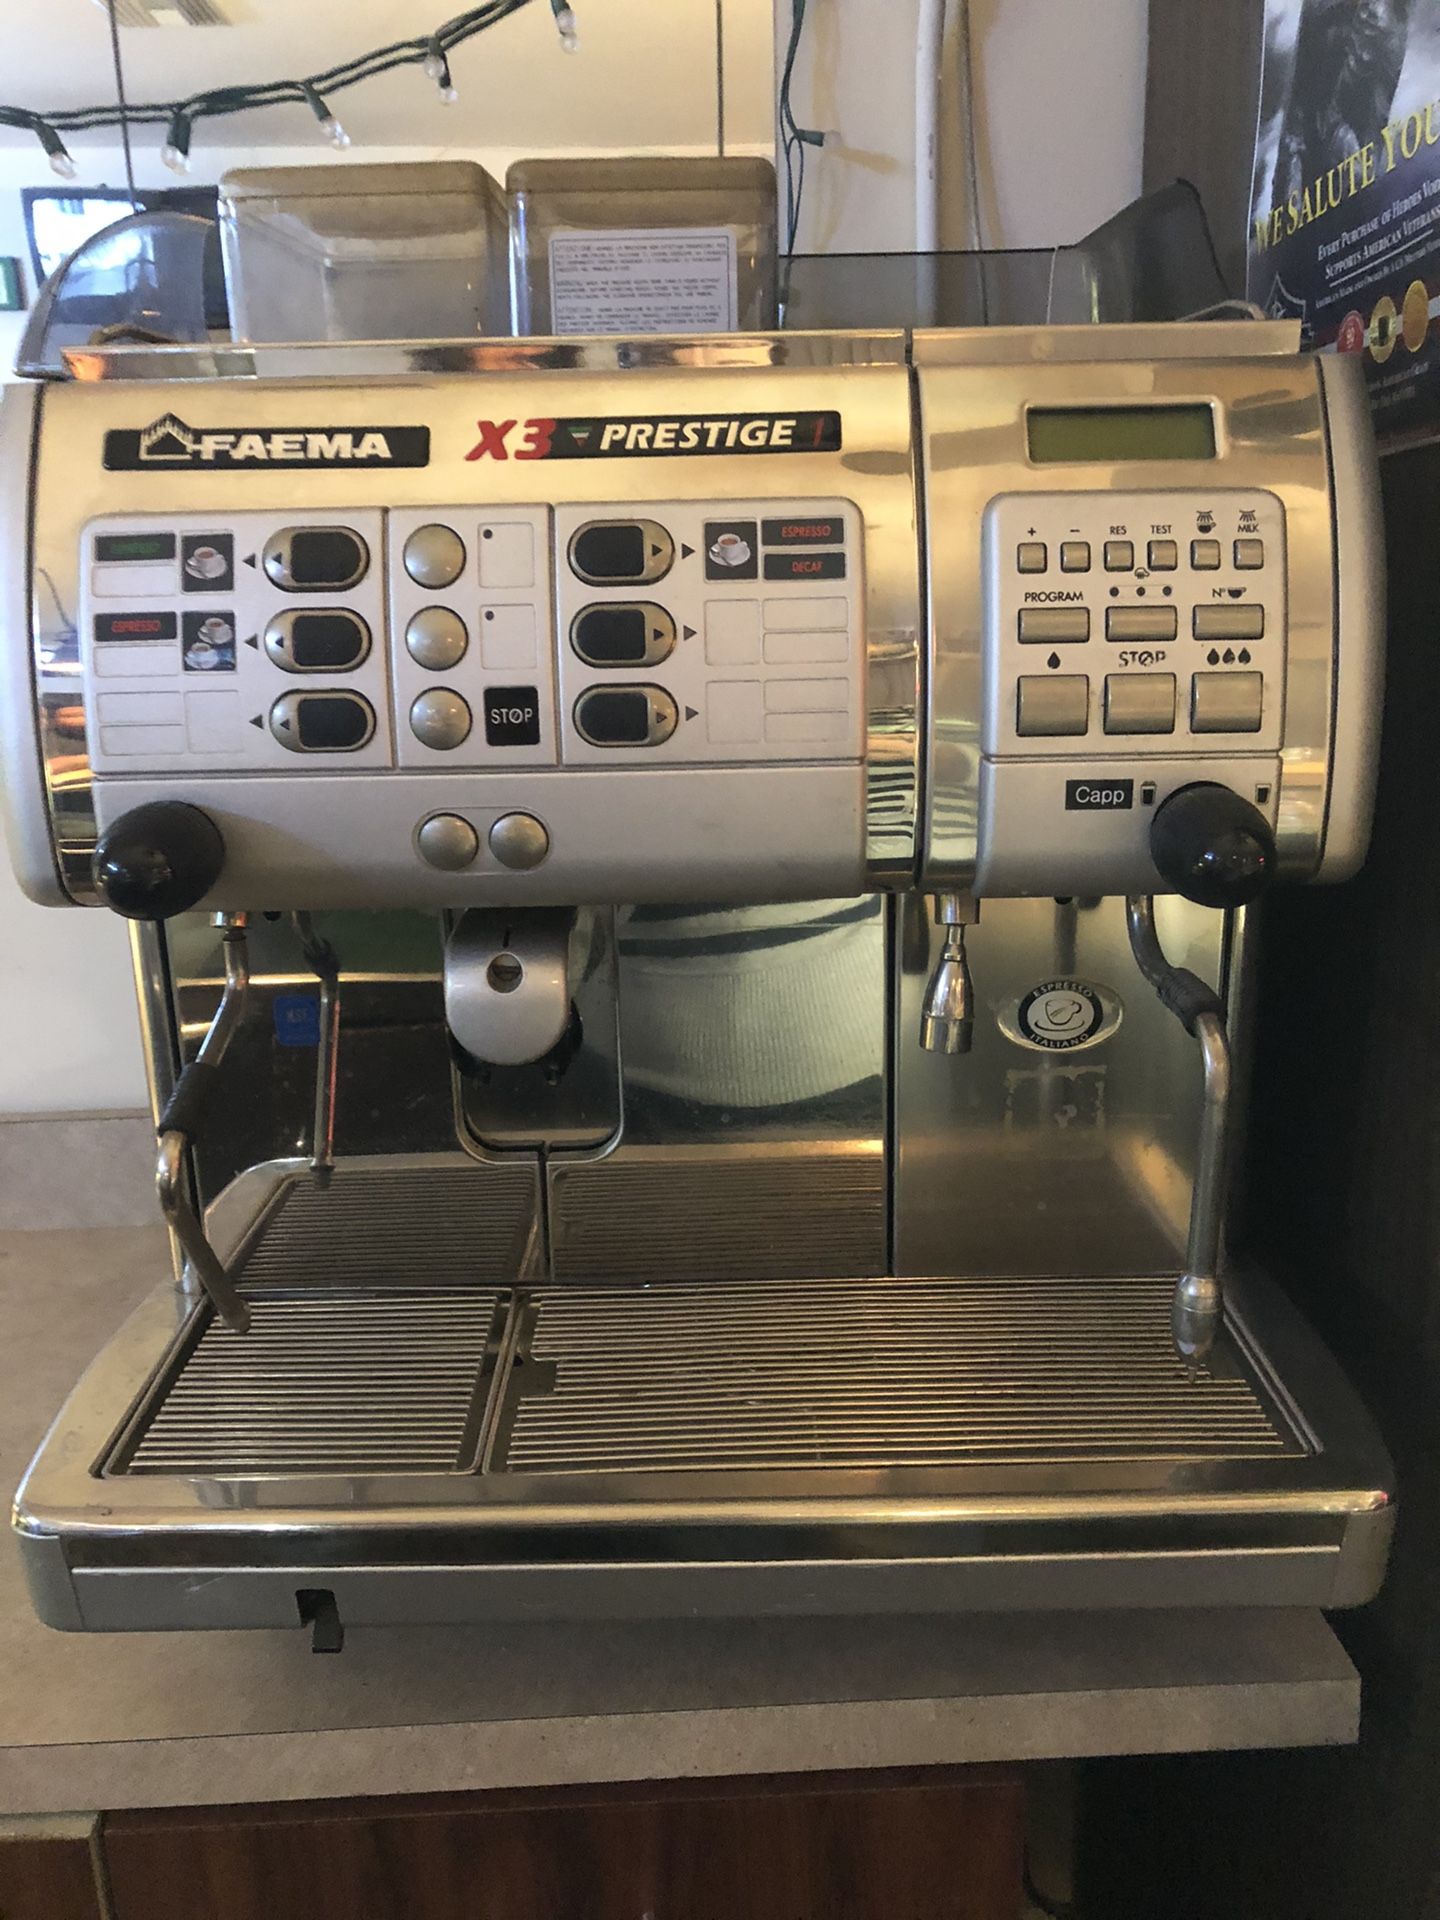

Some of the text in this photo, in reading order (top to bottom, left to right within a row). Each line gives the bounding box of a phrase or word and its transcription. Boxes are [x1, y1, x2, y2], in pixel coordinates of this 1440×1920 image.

[1255, 206, 1284, 255] WE
[1287, 142, 1376, 235] SALUTE
[1325, 251, 1361, 279] SUPPORTS
[1363, 229, 1402, 259] AMERICAN
[197, 432, 392, 460] FAEMA
[464, 417, 556, 461] X3
[600, 419, 797, 451] PRESTIGE
[781, 525, 832, 538] ESPRESSO
[1109, 525, 1127, 535] RES
[1151, 524, 1173, 535] TEST
[792, 561, 823, 573] DECAF
[1024, 591, 1084, 602] PROGRAM
[1119, 650, 1166, 667] STOP
[491, 707, 533, 724] STOP
[1075, 786, 1125, 805] Capp
[1033, 981, 1093, 998] ESPRESSO
[1030, 1033, 1090, 1048] ITALIANO
